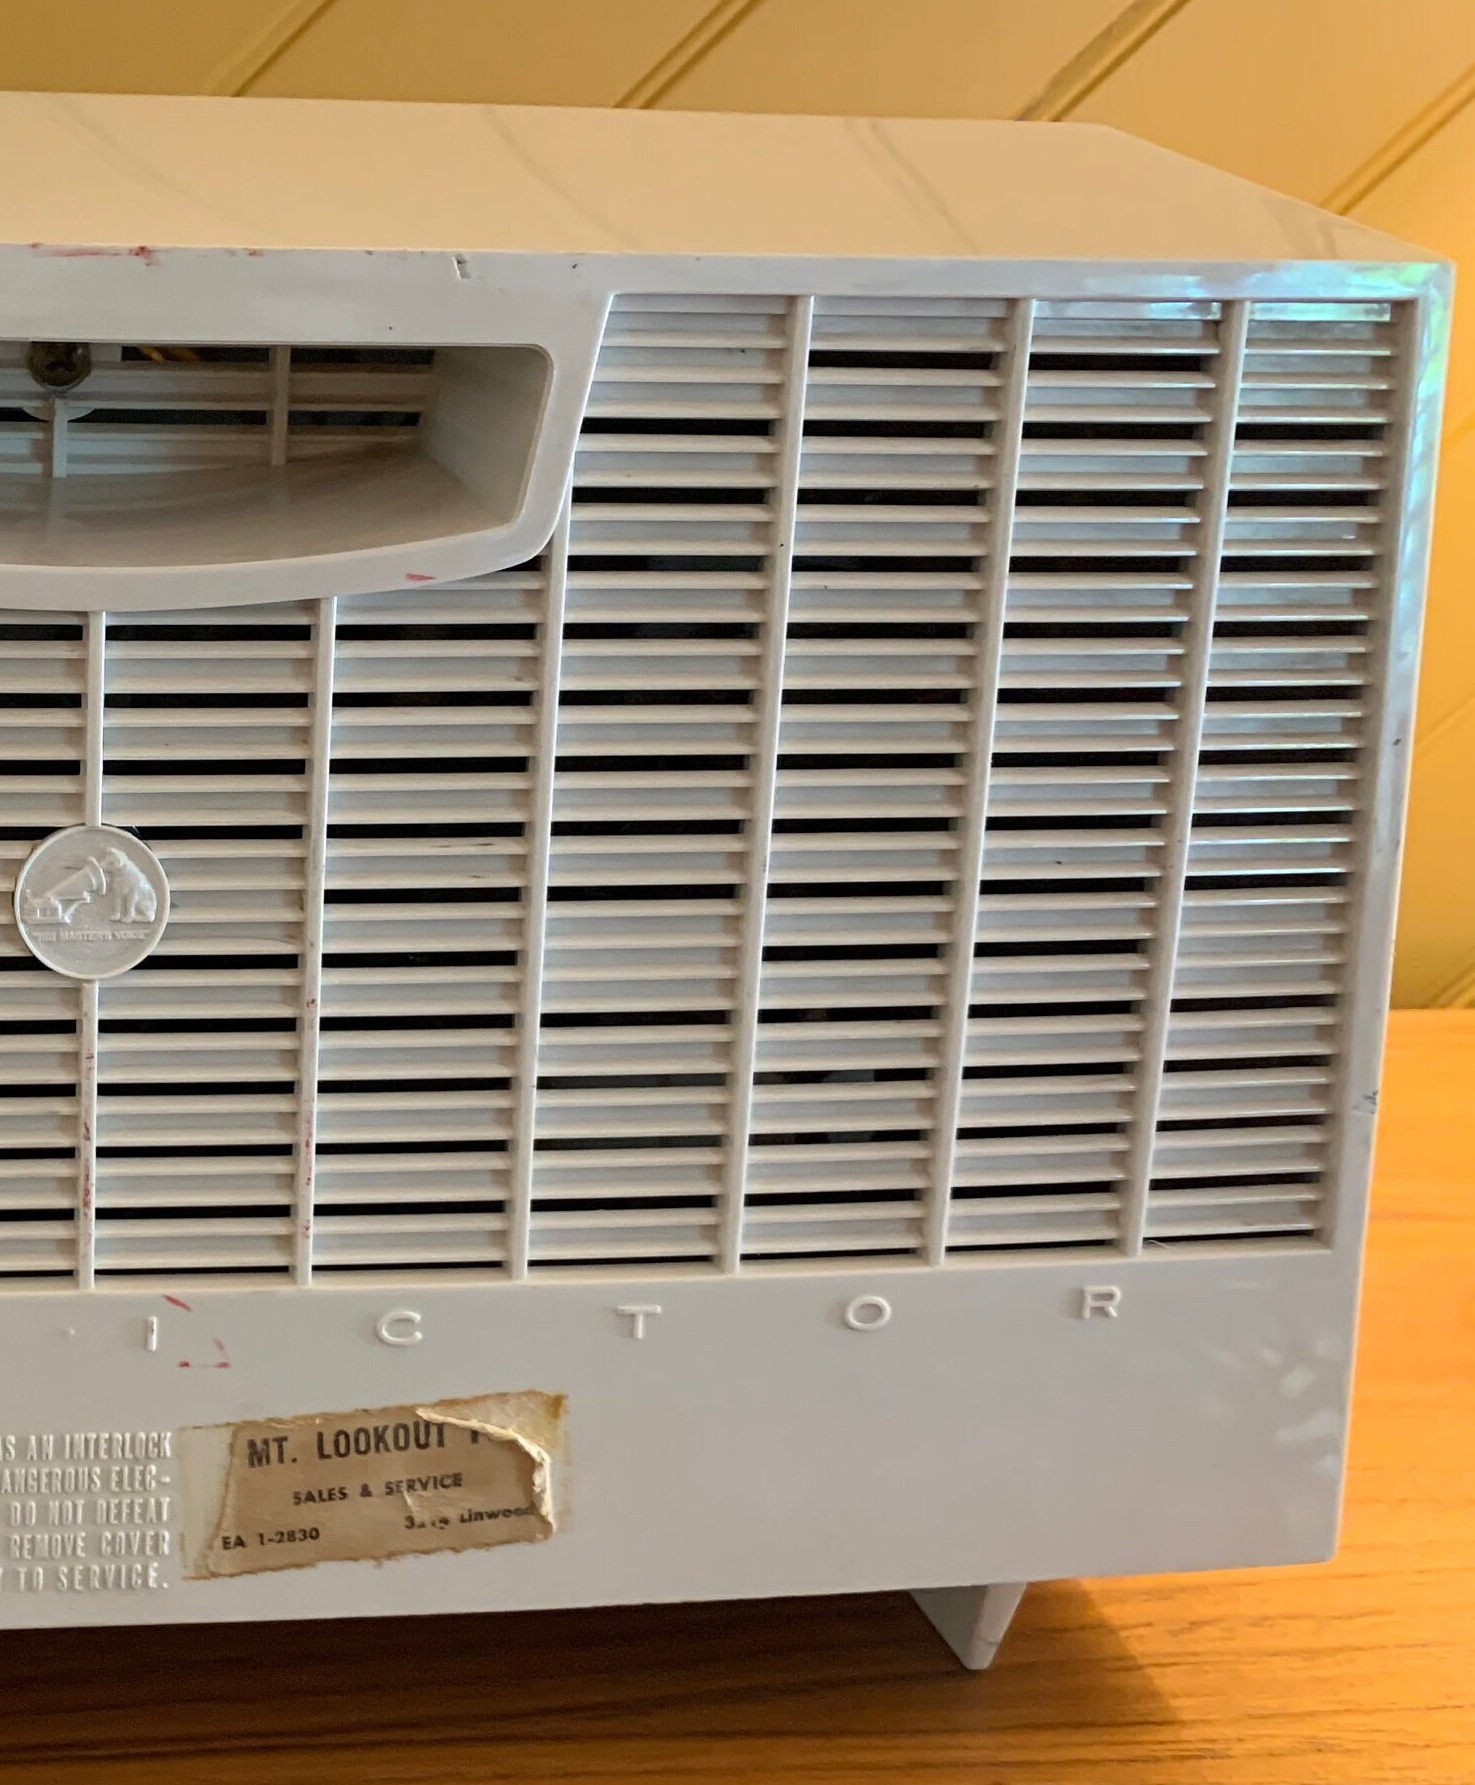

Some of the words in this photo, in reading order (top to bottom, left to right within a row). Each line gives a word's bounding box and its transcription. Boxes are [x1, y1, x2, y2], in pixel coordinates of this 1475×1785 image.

[28, 1434, 54, 1460] AN
[64, 1432, 172, 1460] INTERLOCK
[247, 1436, 298, 1468] MT.
[110, 1465, 171, 1491] ELEC-
[293, 1486, 348, 1505] SALES
[360, 1483, 373, 1497] &
[385, 1473, 463, 1495] SERVICE
[10, 1501, 37, 1527] DO
[48, 1499, 85, 1525] NOT
[96, 1497, 171, 1524] DEFEAT
[9, 1532, 86, 1560] REMOVE
[101, 1531, 170, 1556] COVER
[221, 1535, 245, 1550] EA
[257, 1527, 320, 1545] 1-2830
[17, 1568, 44, 1592] TO
[57, 1562, 170, 1591] SERVICE.
